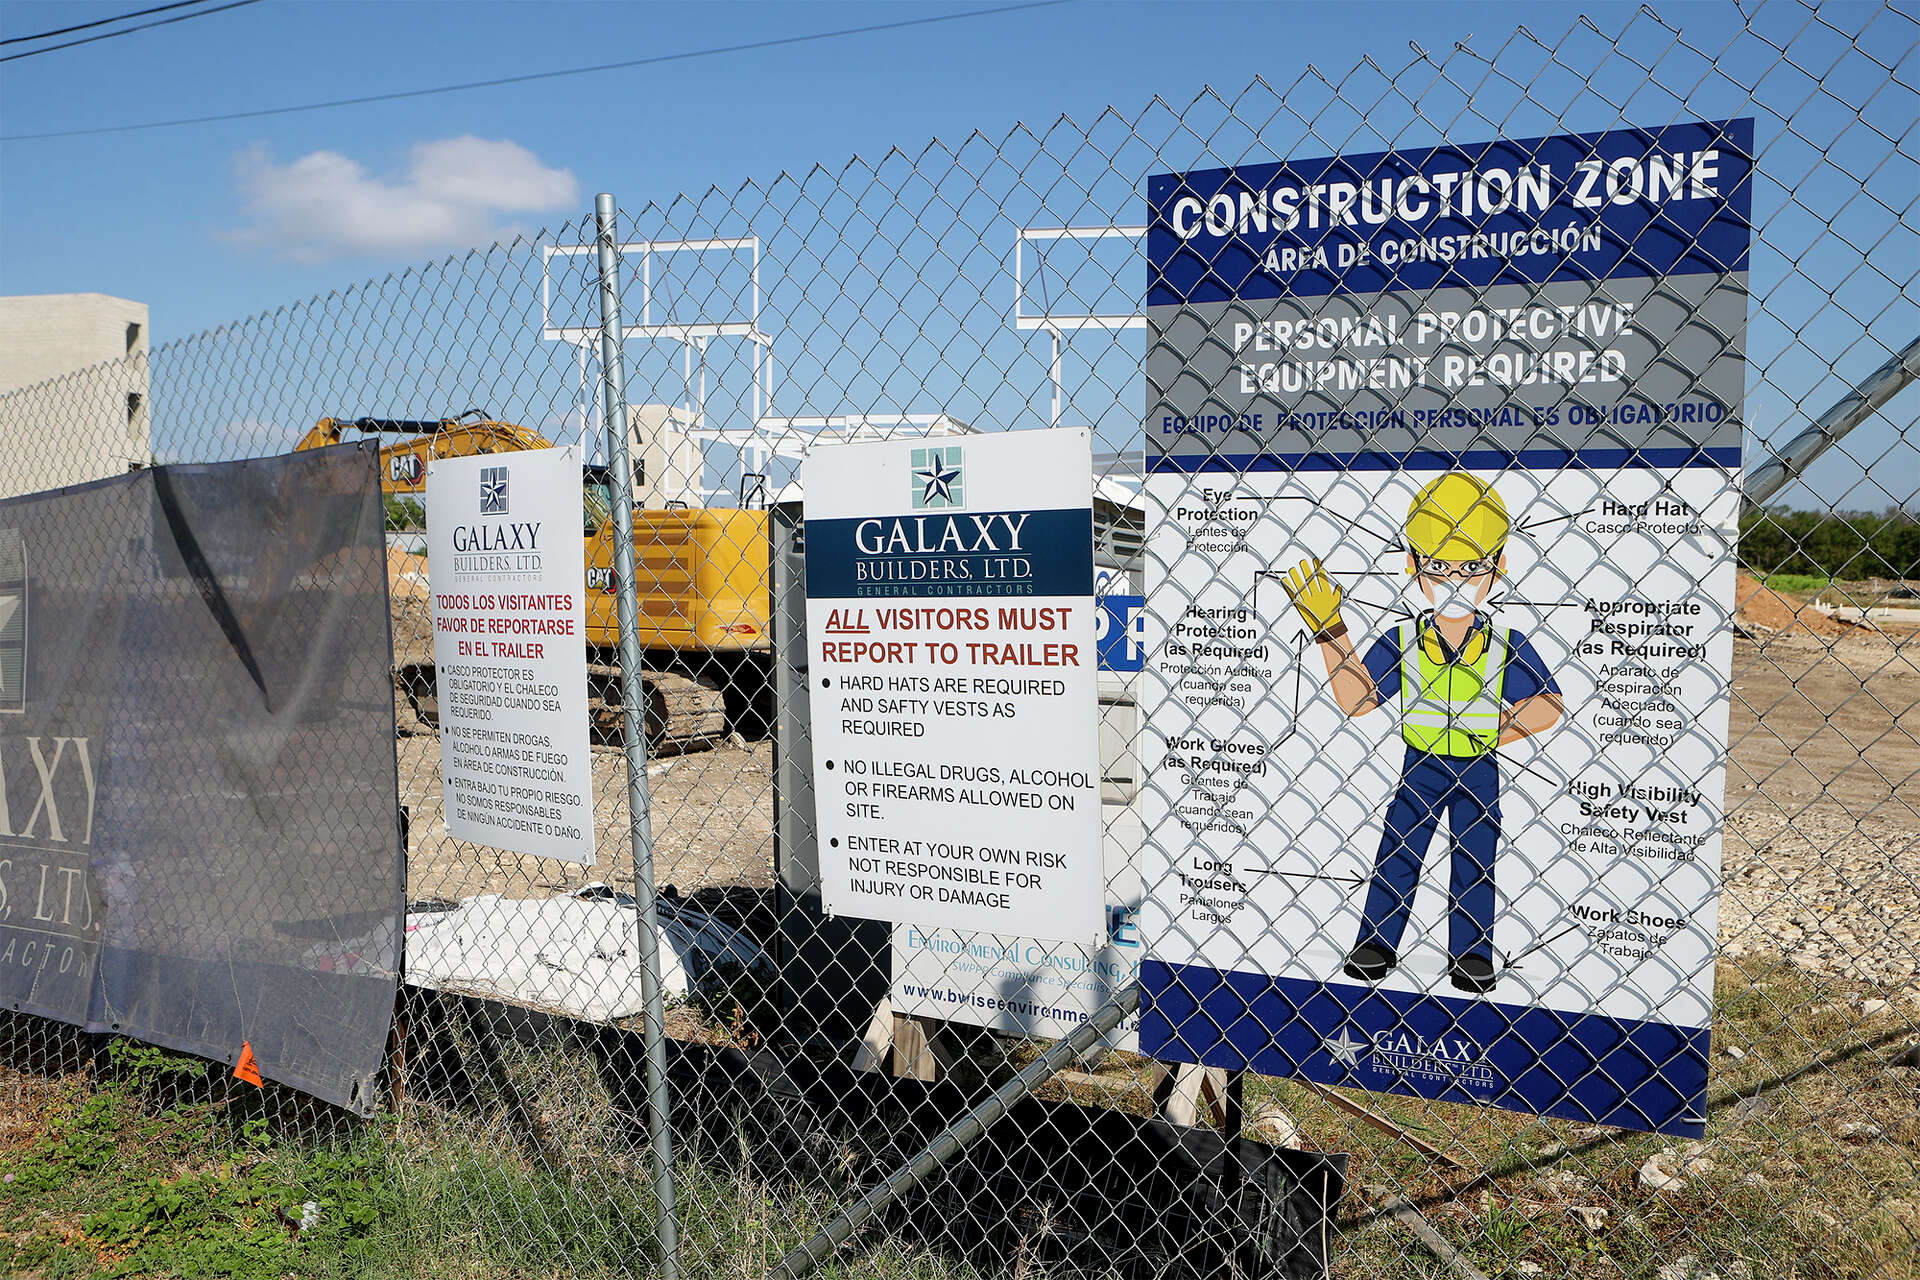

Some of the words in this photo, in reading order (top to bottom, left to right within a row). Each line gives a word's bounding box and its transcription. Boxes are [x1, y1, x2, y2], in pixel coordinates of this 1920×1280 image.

[1173, 162, 1552, 239] CONSTRUCTION
[1572, 149, 1720, 208] ZONE
[1338, 243, 1371, 267] DE
[1381, 222, 1601, 264] CONSTRUCCIÓN
[1234, 310, 1405, 352] PERSONAL
[1417, 304, 1633, 345] PROTECTIVE
[1239, 358, 1428, 394] EQUIPMENT
[1444, 350, 1626, 388] REQUIRED
[1162, 414, 1232, 435] EQUIPO
[1238, 414, 1262, 432] DE
[1278, 406, 1404, 432] PROTECCIÓN
[1413, 406, 1528, 428] PERSONAL
[1533, 405, 1560, 426] ES
[1568, 402, 1722, 428] OBLIGATORIO
[1204, 488, 1232, 504] Eye
[1177, 508, 1258, 521] Protection
[1603, 501, 1648, 516] Hard
[1656, 502, 1688, 516] Hat
[454, 523, 541, 551] GALAXY
[855, 514, 1031, 555] GALAXY
[1189, 526, 1227, 537] Lentes
[1231, 527, 1246, 537] de
[1586, 521, 1631, 534] Casco
[1637, 522, 1704, 534] Protector
[454, 556, 510, 572] BUILDERS,
[517, 555, 542, 570] LTD.
[856, 558, 972, 582] BUILDERS,
[984, 557, 1032, 578] LTD.
[857, 584, 917, 596] GENERAL
[927, 584, 1033, 594] CONTRACTORS
[436, 594, 469, 610] TODOS
[473, 594, 494, 610] LOS
[498, 594, 572, 610] VISITANTES
[1584, 599, 1701, 618] Appropriate
[825, 608, 870, 634] ALL
[876, 608, 990, 630] VISITORS
[999, 608, 1072, 630] MUST
[1186, 605, 1246, 622] Hearing
[437, 618, 467, 632] FAVOR
[471, 618, 485, 633] DE
[489, 618, 574, 635] REPORTARSE
[1176, 624, 1256, 639] Protection
[1591, 619, 1693, 637] Respirator
[459, 641, 472, 656] EN
[475, 641, 489, 657] EL
[492, 643, 544, 659] TRAILER
[823, 642, 918, 664] REPORT
[925, 643, 958, 665] TO
[966, 643, 1080, 666] TRAILER
[1164, 642, 1187, 658] (as
[1193, 643, 1269, 662] Required)
[1576, 640, 1603, 658] (as
[1611, 641, 1706, 662] Required)
[448, 665, 470, 677] CASCO
[472, 666, 520, 680] PROTECTOR
[523, 669, 534, 680] ES
[1225, 665, 1272, 678] Auditiva
[1662, 666, 1679, 678] de
[449, 679, 495, 692] OBLIGATORIO
[497, 683, 503, 693] Y
[504, 683, 514, 694] EL
[516, 684, 558, 696] CHALECO
[840, 676, 884, 691] HARD
[888, 677, 929, 692] HATS
[934, 679, 968, 693] ARE
[973, 679, 1065, 696] REQUIRED
[1230, 683, 1251, 692] sea
[450, 692, 458, 703] DE
[460, 694, 502, 707] SEGURIDAD
[504, 698, 540, 711] CUANDO
[543, 700, 561, 712] SEA
[841, 698, 874, 713] AND
[878, 699, 929, 715] SAFTY
[934, 701, 988, 717] VESTS
[993, 702, 1016, 718] AS
[1601, 698, 1674, 712] Adecuado
[451, 706, 494, 720] REQUERIDO.
[1593, 714, 1651, 728] (cuando
[1656, 719, 1682, 730] sea
[452, 726, 461, 737] NO
[462, 728, 471, 738] SE
[473, 729, 511, 743] PERMITEN
[513, 733, 553, 748] DROGAS,
[842, 720, 925, 737] REQUIRED
[452, 742, 484, 755] ALCOHOL
[485, 746, 491, 755] O
[492, 747, 519, 761] ARMAS
[522, 750, 534, 761] DE
[536, 750, 568, 765] FUEGO
[1166, 736, 1205, 751] Work
[1210, 738, 1264, 755] Gloves
[454, 757, 463, 768] EN
[483, 761, 494, 772] DE
[495, 764, 566, 783] CONSTRUCCIÓN.
[844, 760, 867, 775] NO
[871, 761, 935, 780] ILLEGAL
[940, 765, 1005, 786] DRUGS,
[1009, 770, 1094, 789] ALCOHOL
[1191, 756, 1267, 777] Required)
[455, 778, 477, 791] ENTRA
[478, 781, 497, 794] BAJO
[498, 784, 508, 796] TU
[511, 785, 543, 801] PROPIO
[545, 791, 584, 807] RIESGO.
[845, 782, 868, 797] OR
[873, 784, 954, 803] FIREARMS
[959, 790, 1043, 808] ALLOWED
[1048, 794, 1074, 811] ON
[1569, 781, 1611, 800] High
[1618, 783, 1702, 807] Visibility
[456, 794, 465, 804] NO
[466, 794, 493, 809] SOMOS
[495, 800, 562, 820] RESPONSABLES
[846, 804, 885, 820] SITE.
[1580, 802, 1639, 823] Safety
[1646, 807, 1687, 824] Vest
[457, 808, 467, 819] DE
[468, 810, 495, 826] NINGÚN
[496, 817, 543, 835] ACCIDENTE
[545, 825, 552, 835] O
[555, 825, 584, 840] DAÑO.
[1624, 828, 1706, 845] Reflectante
[848, 836, 900, 855] ENTER
[903, 841, 923, 856] AT
[927, 842, 974, 860] YOUR
[979, 847, 1020, 864] OWN
[1026, 851, 1067, 869] RISK
[1570, 842, 1586, 852] de
[1590, 842, 1617, 854] Alta
[849, 857, 882, 873] NOT
[885, 861, 1000, 886] RESPONSIBLE
[1006, 873, 1042, 890] FOR
[1194, 857, 1233, 876] Long
[1179, 874, 1247, 893] Trousers
[851, 879, 905, 898] INJURY
[910, 885, 934, 901] OR
[938, 889, 1011, 909] DAMAGE
[1192, 910, 1232, 924] Largos
[1571, 905, 1620, 923] Work
[1627, 910, 1687, 930] Shoes
[1588, 926, 1645, 942] Zapatos
